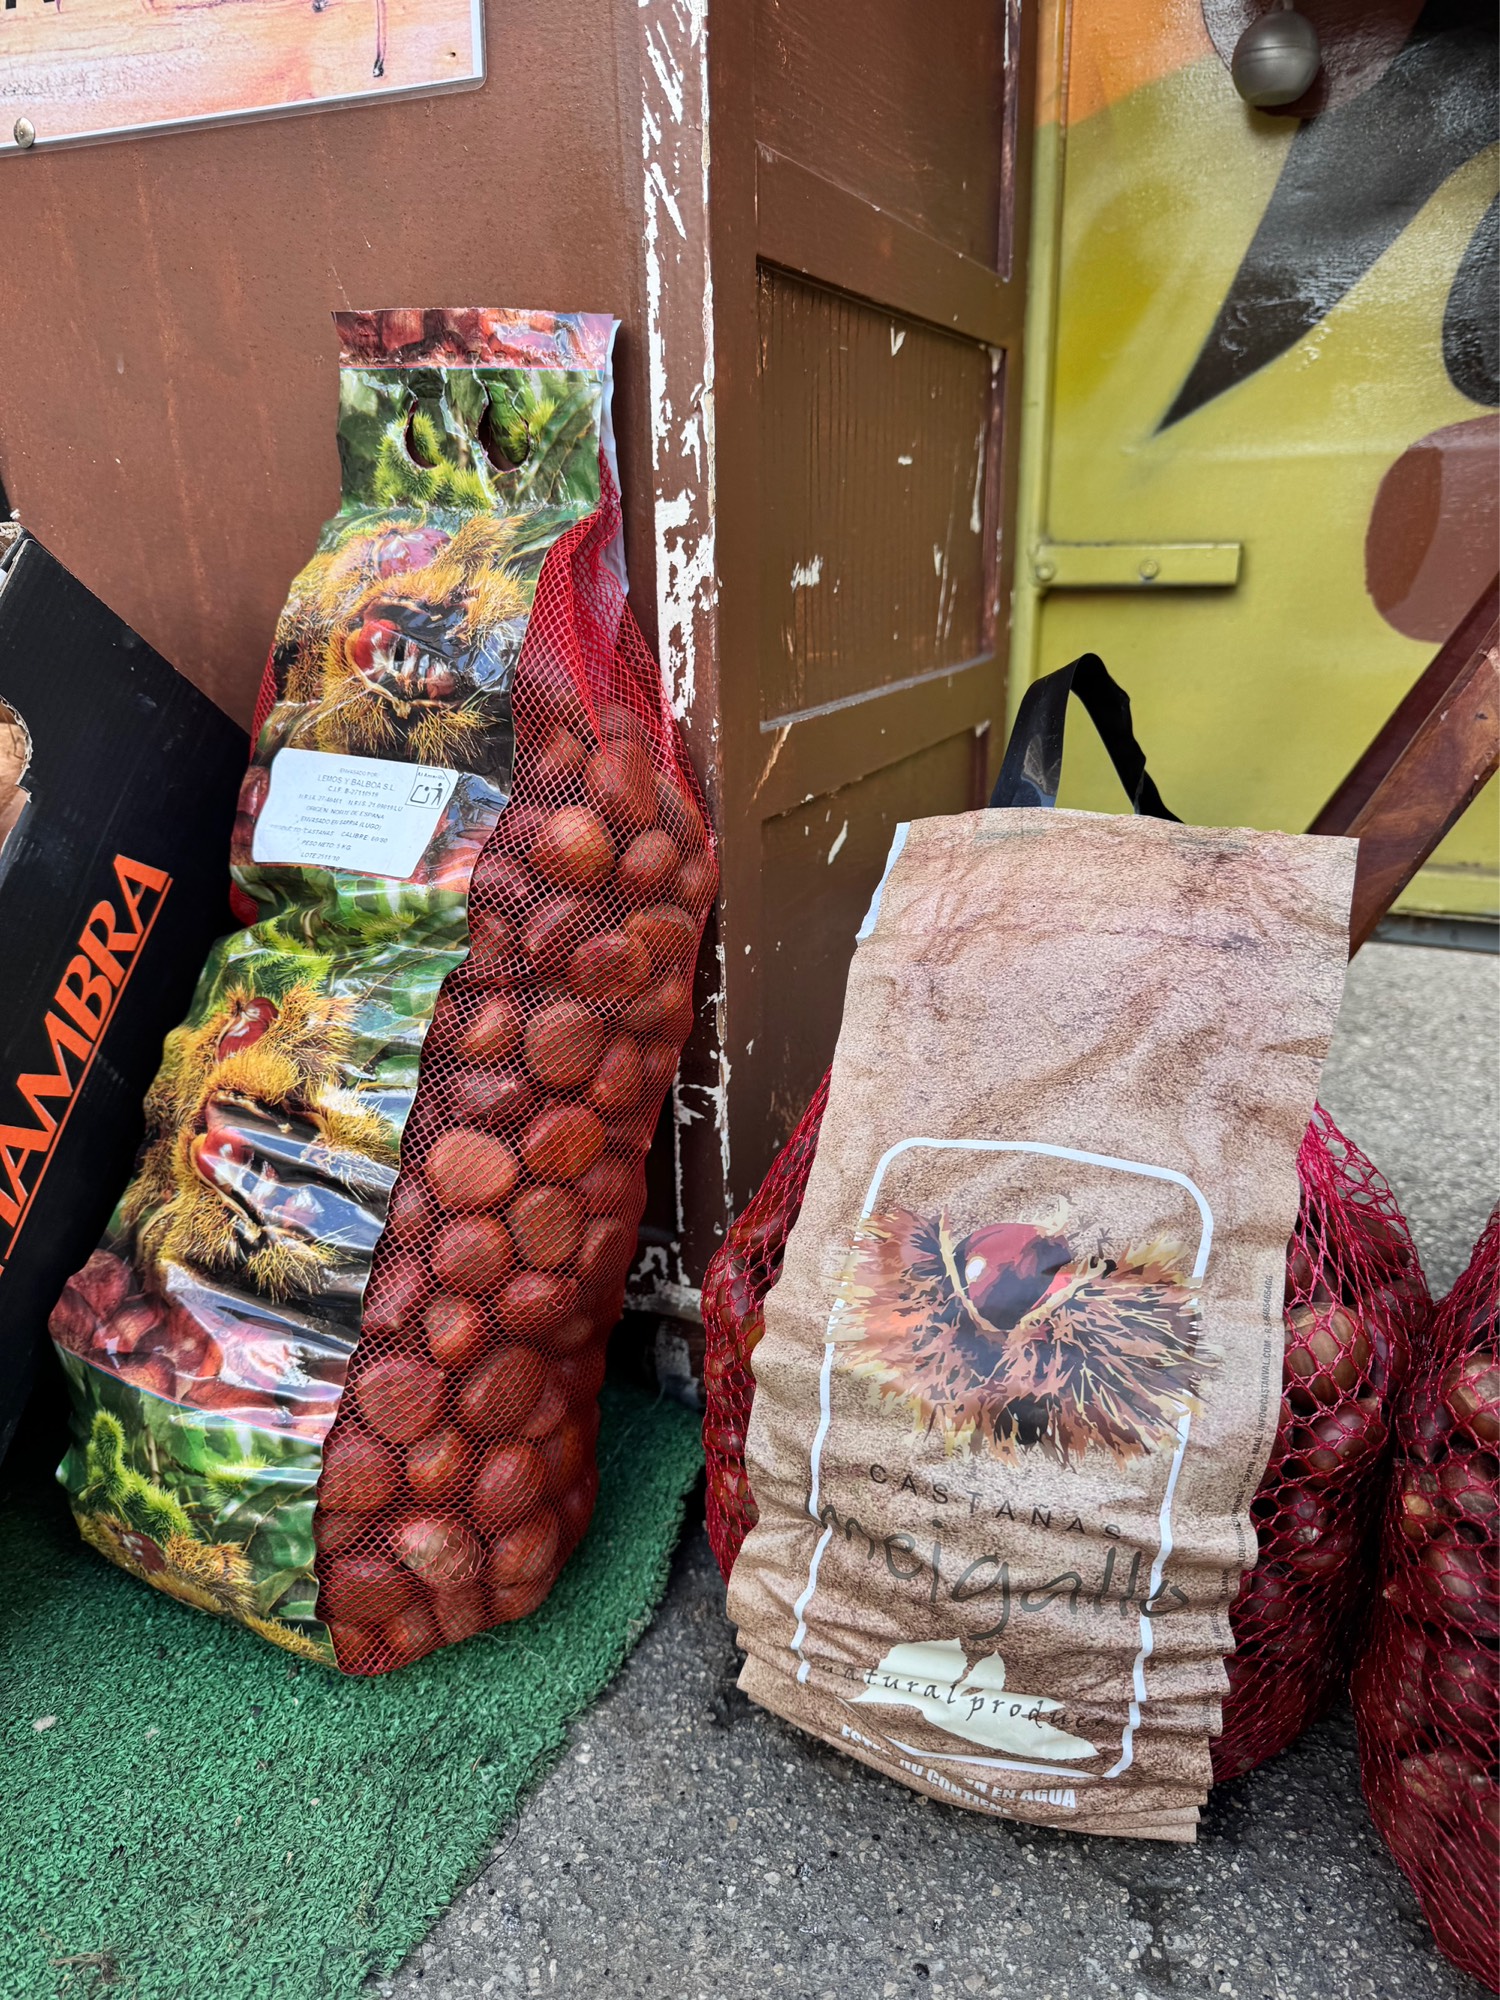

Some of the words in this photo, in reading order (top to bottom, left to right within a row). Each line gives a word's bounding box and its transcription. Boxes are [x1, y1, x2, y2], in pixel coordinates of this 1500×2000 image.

[317, 774, 343, 785] LEMOS
[351, 779, 382, 790] BALBOA
[302, 839, 318, 847] PESO
[0, 853, 170, 1229] AMBRA
[1257, 1340, 1272, 1432] INFO@CASTANVAL.COM
[1251, 1433, 1264, 1456] MAIL:
[1242, 1460, 1257, 1483] SPAIN
[869, 1463, 1121, 1540] CASTAÑAS
[1019, 1788, 1077, 1810] AGUA
